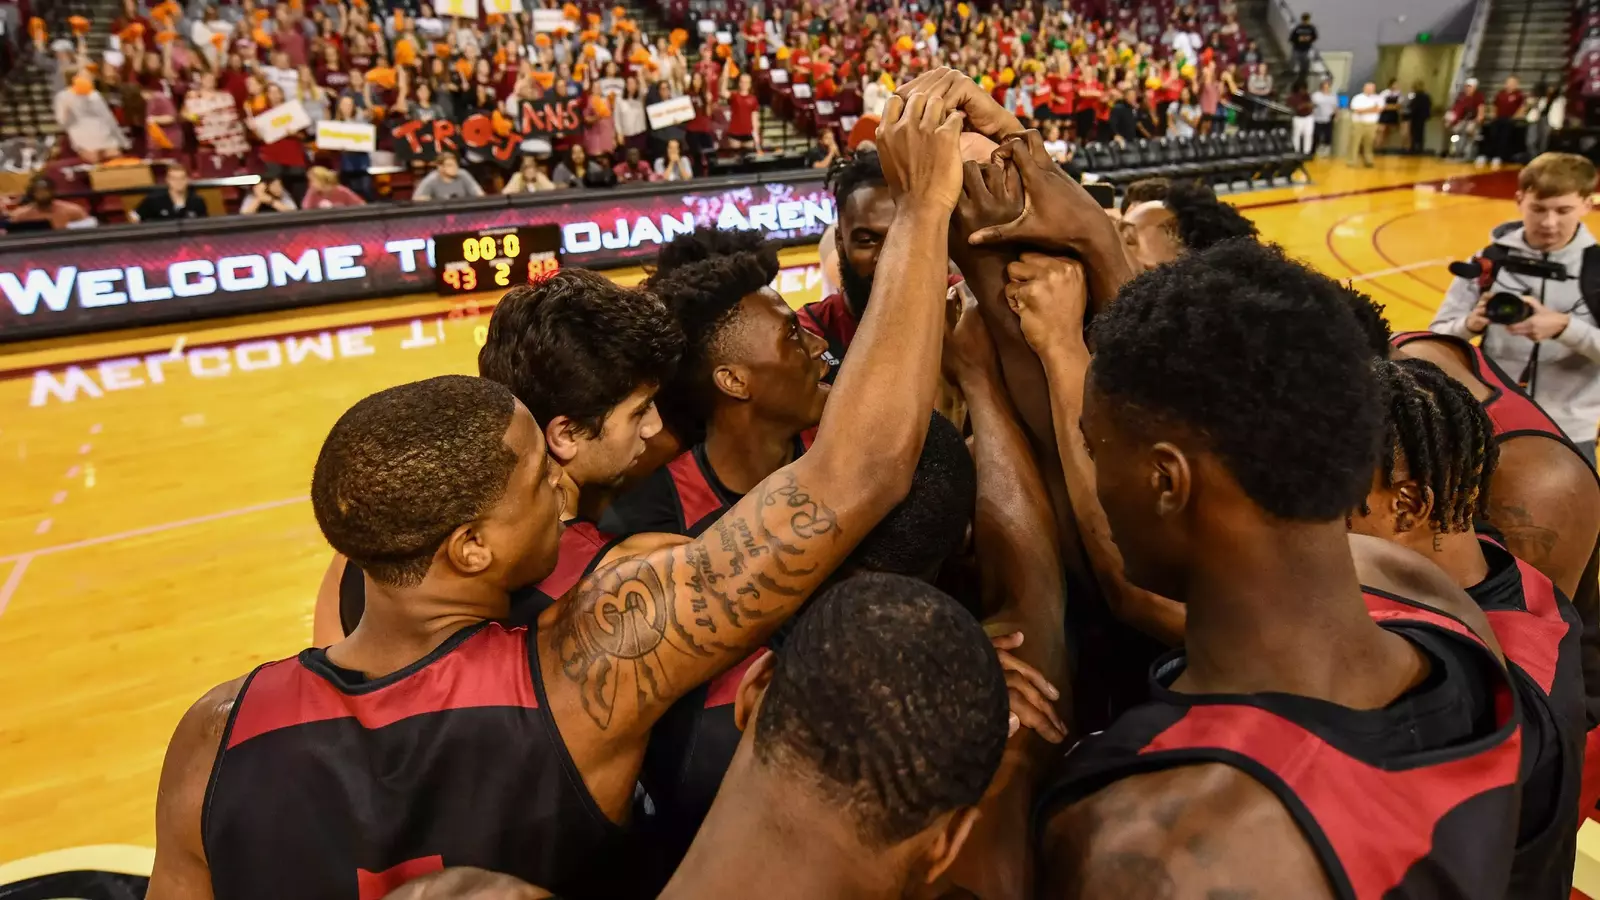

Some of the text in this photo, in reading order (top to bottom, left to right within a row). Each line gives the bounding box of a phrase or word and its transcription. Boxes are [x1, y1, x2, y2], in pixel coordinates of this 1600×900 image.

[0, 198, 838, 315] WELCOME T OJAN AREN
[443, 265, 477, 290] 93
[495, 263, 510, 286] 2
